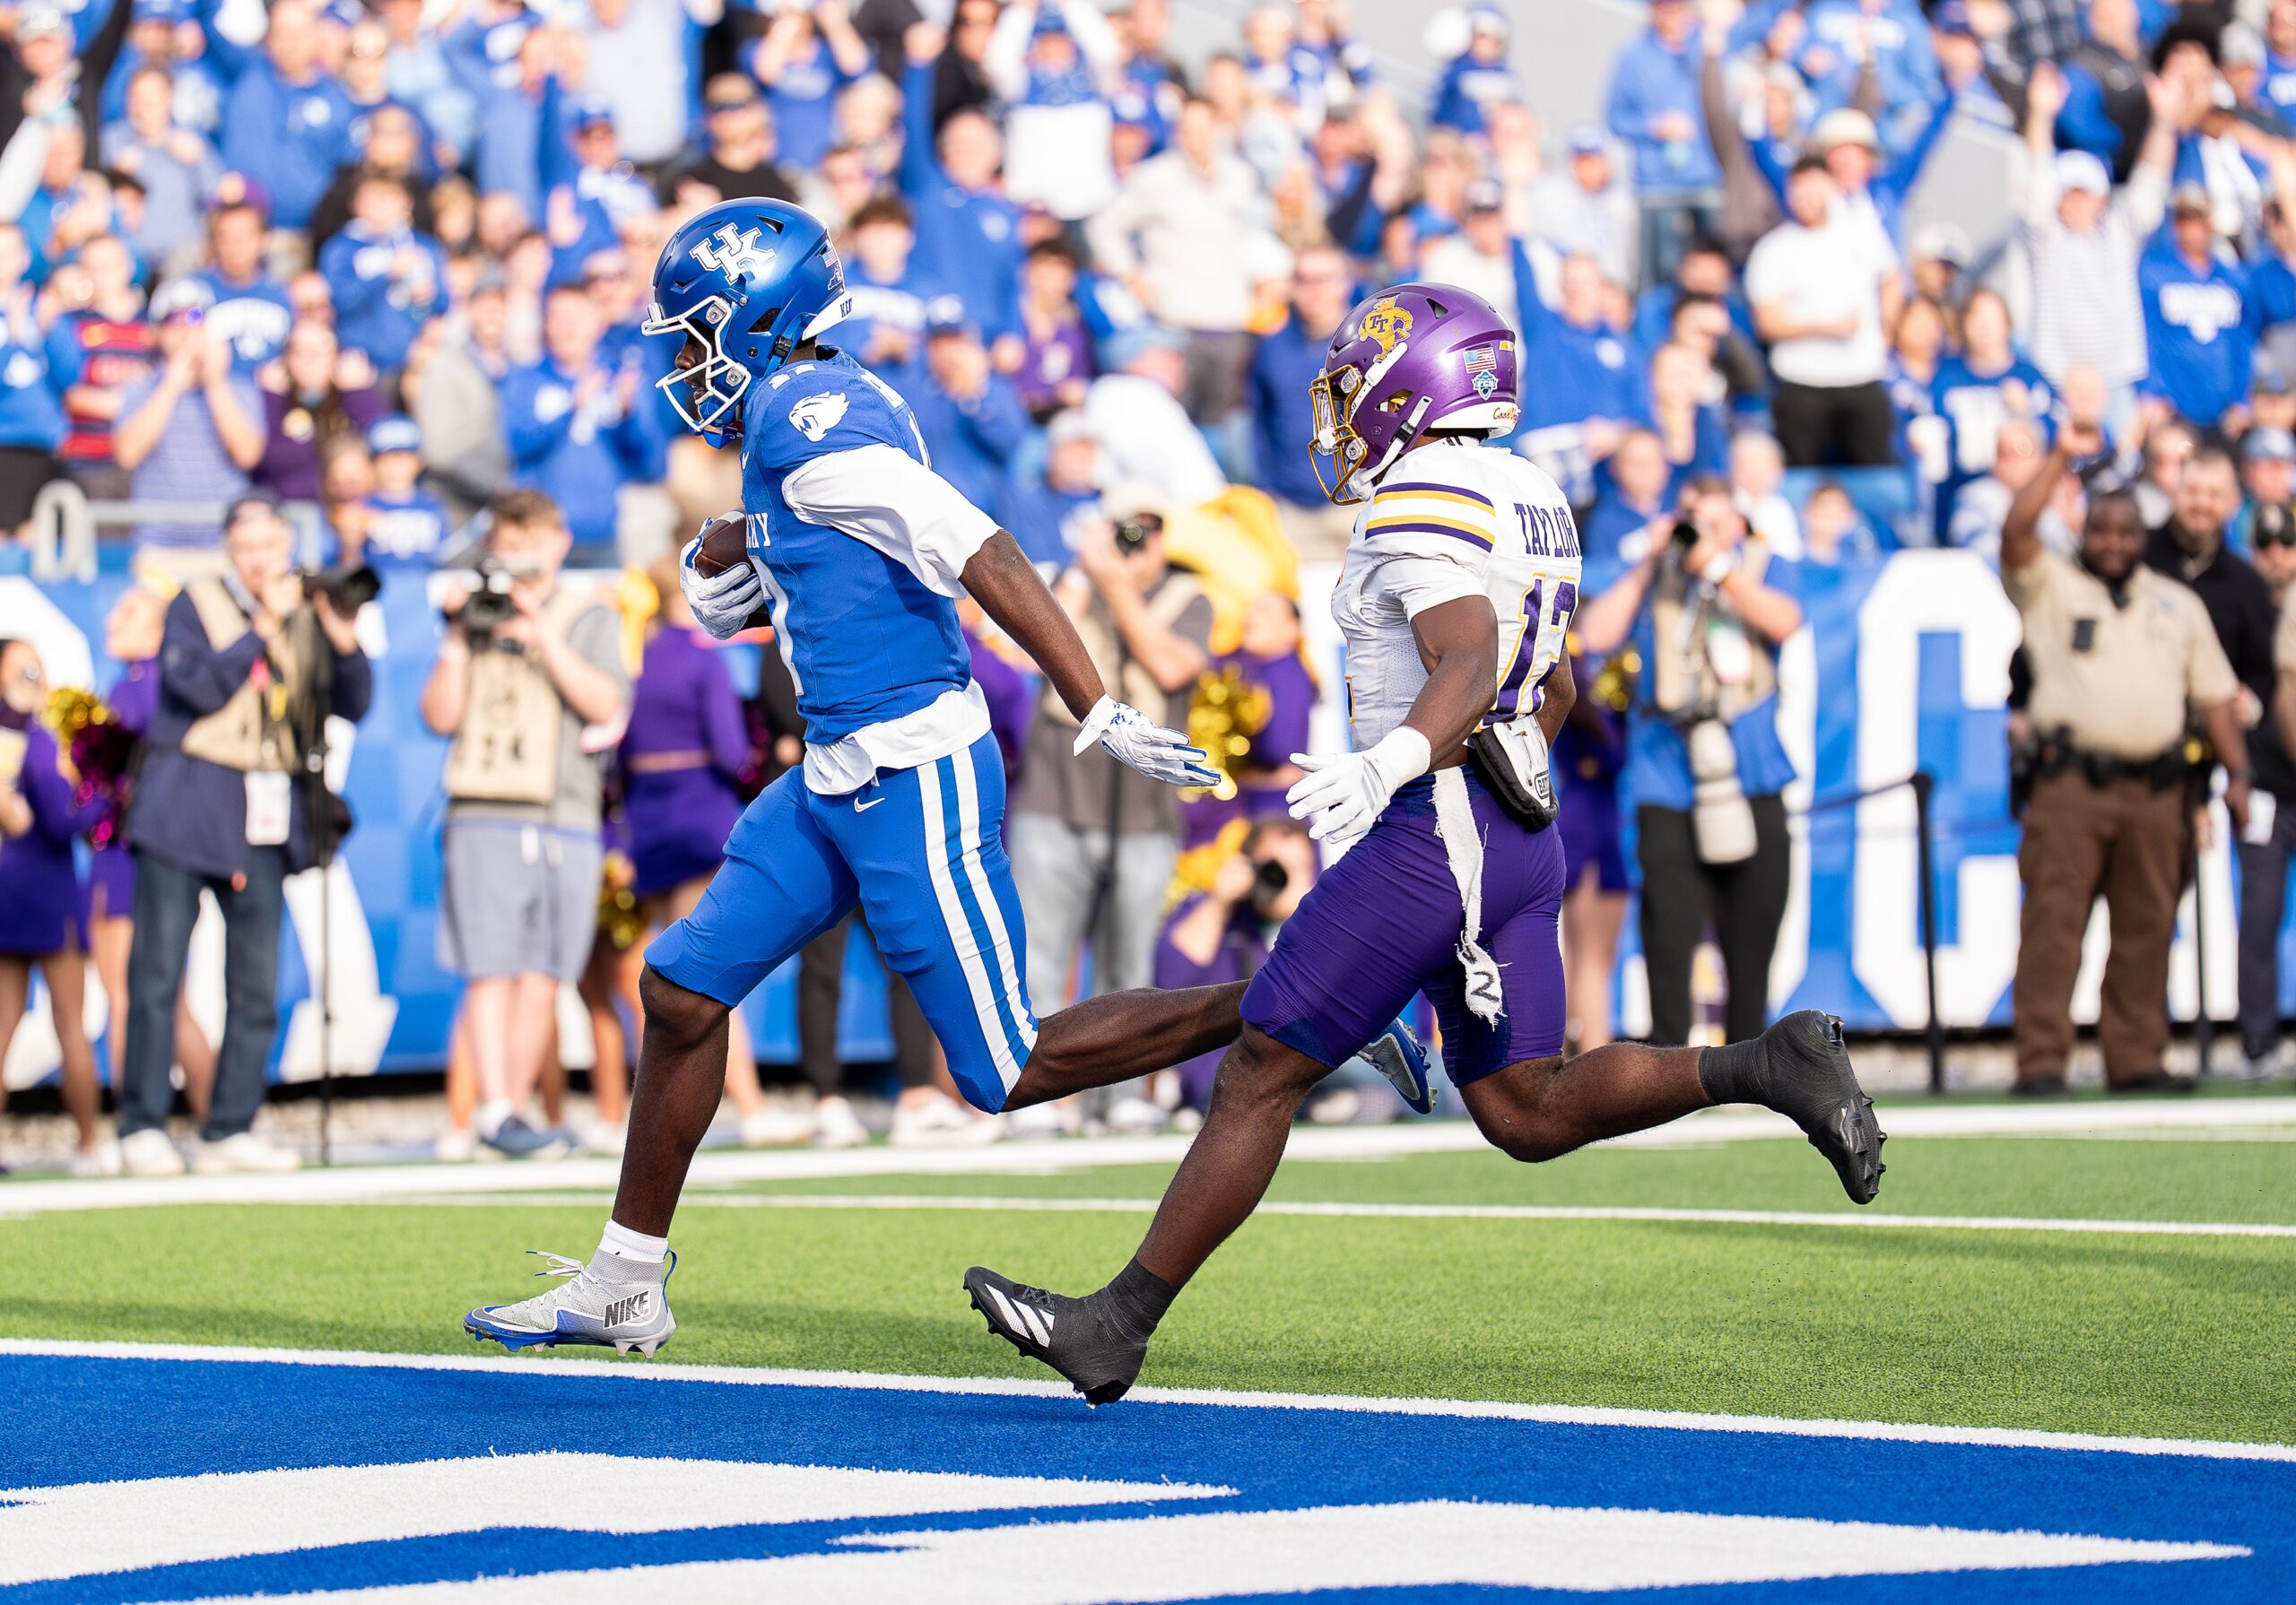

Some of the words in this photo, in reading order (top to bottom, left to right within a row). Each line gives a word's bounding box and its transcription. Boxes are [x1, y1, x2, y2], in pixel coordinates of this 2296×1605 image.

[1370, 314, 1388, 334] TT
[1513, 502, 1580, 558] TAYLOR
[604, 1289, 649, 1329] NIKE
